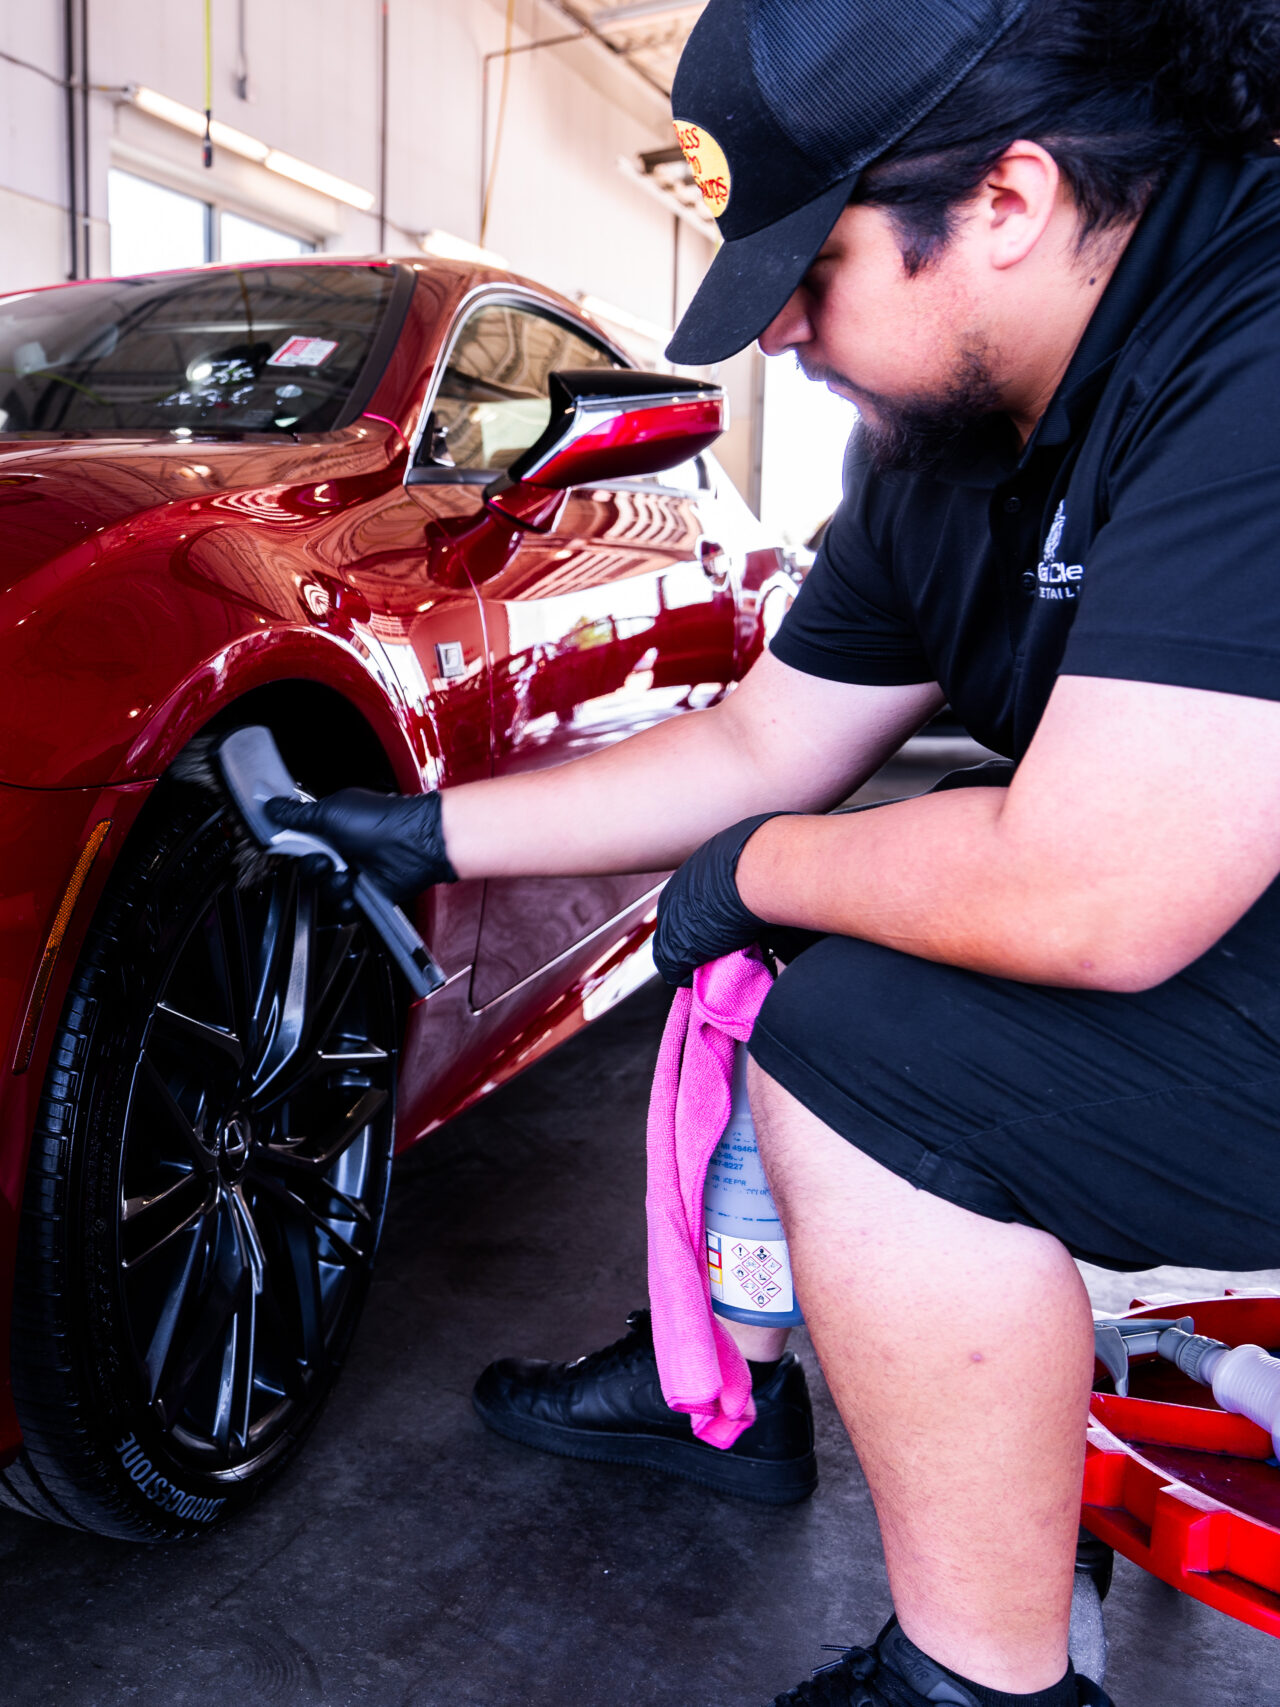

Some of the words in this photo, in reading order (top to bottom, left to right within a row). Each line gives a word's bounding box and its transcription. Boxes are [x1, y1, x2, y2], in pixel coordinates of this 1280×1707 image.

[673, 123, 700, 151] ass
[732, 1145, 758, 1153] 49464
[114, 1431, 227, 1524] BRIDGESTONE
